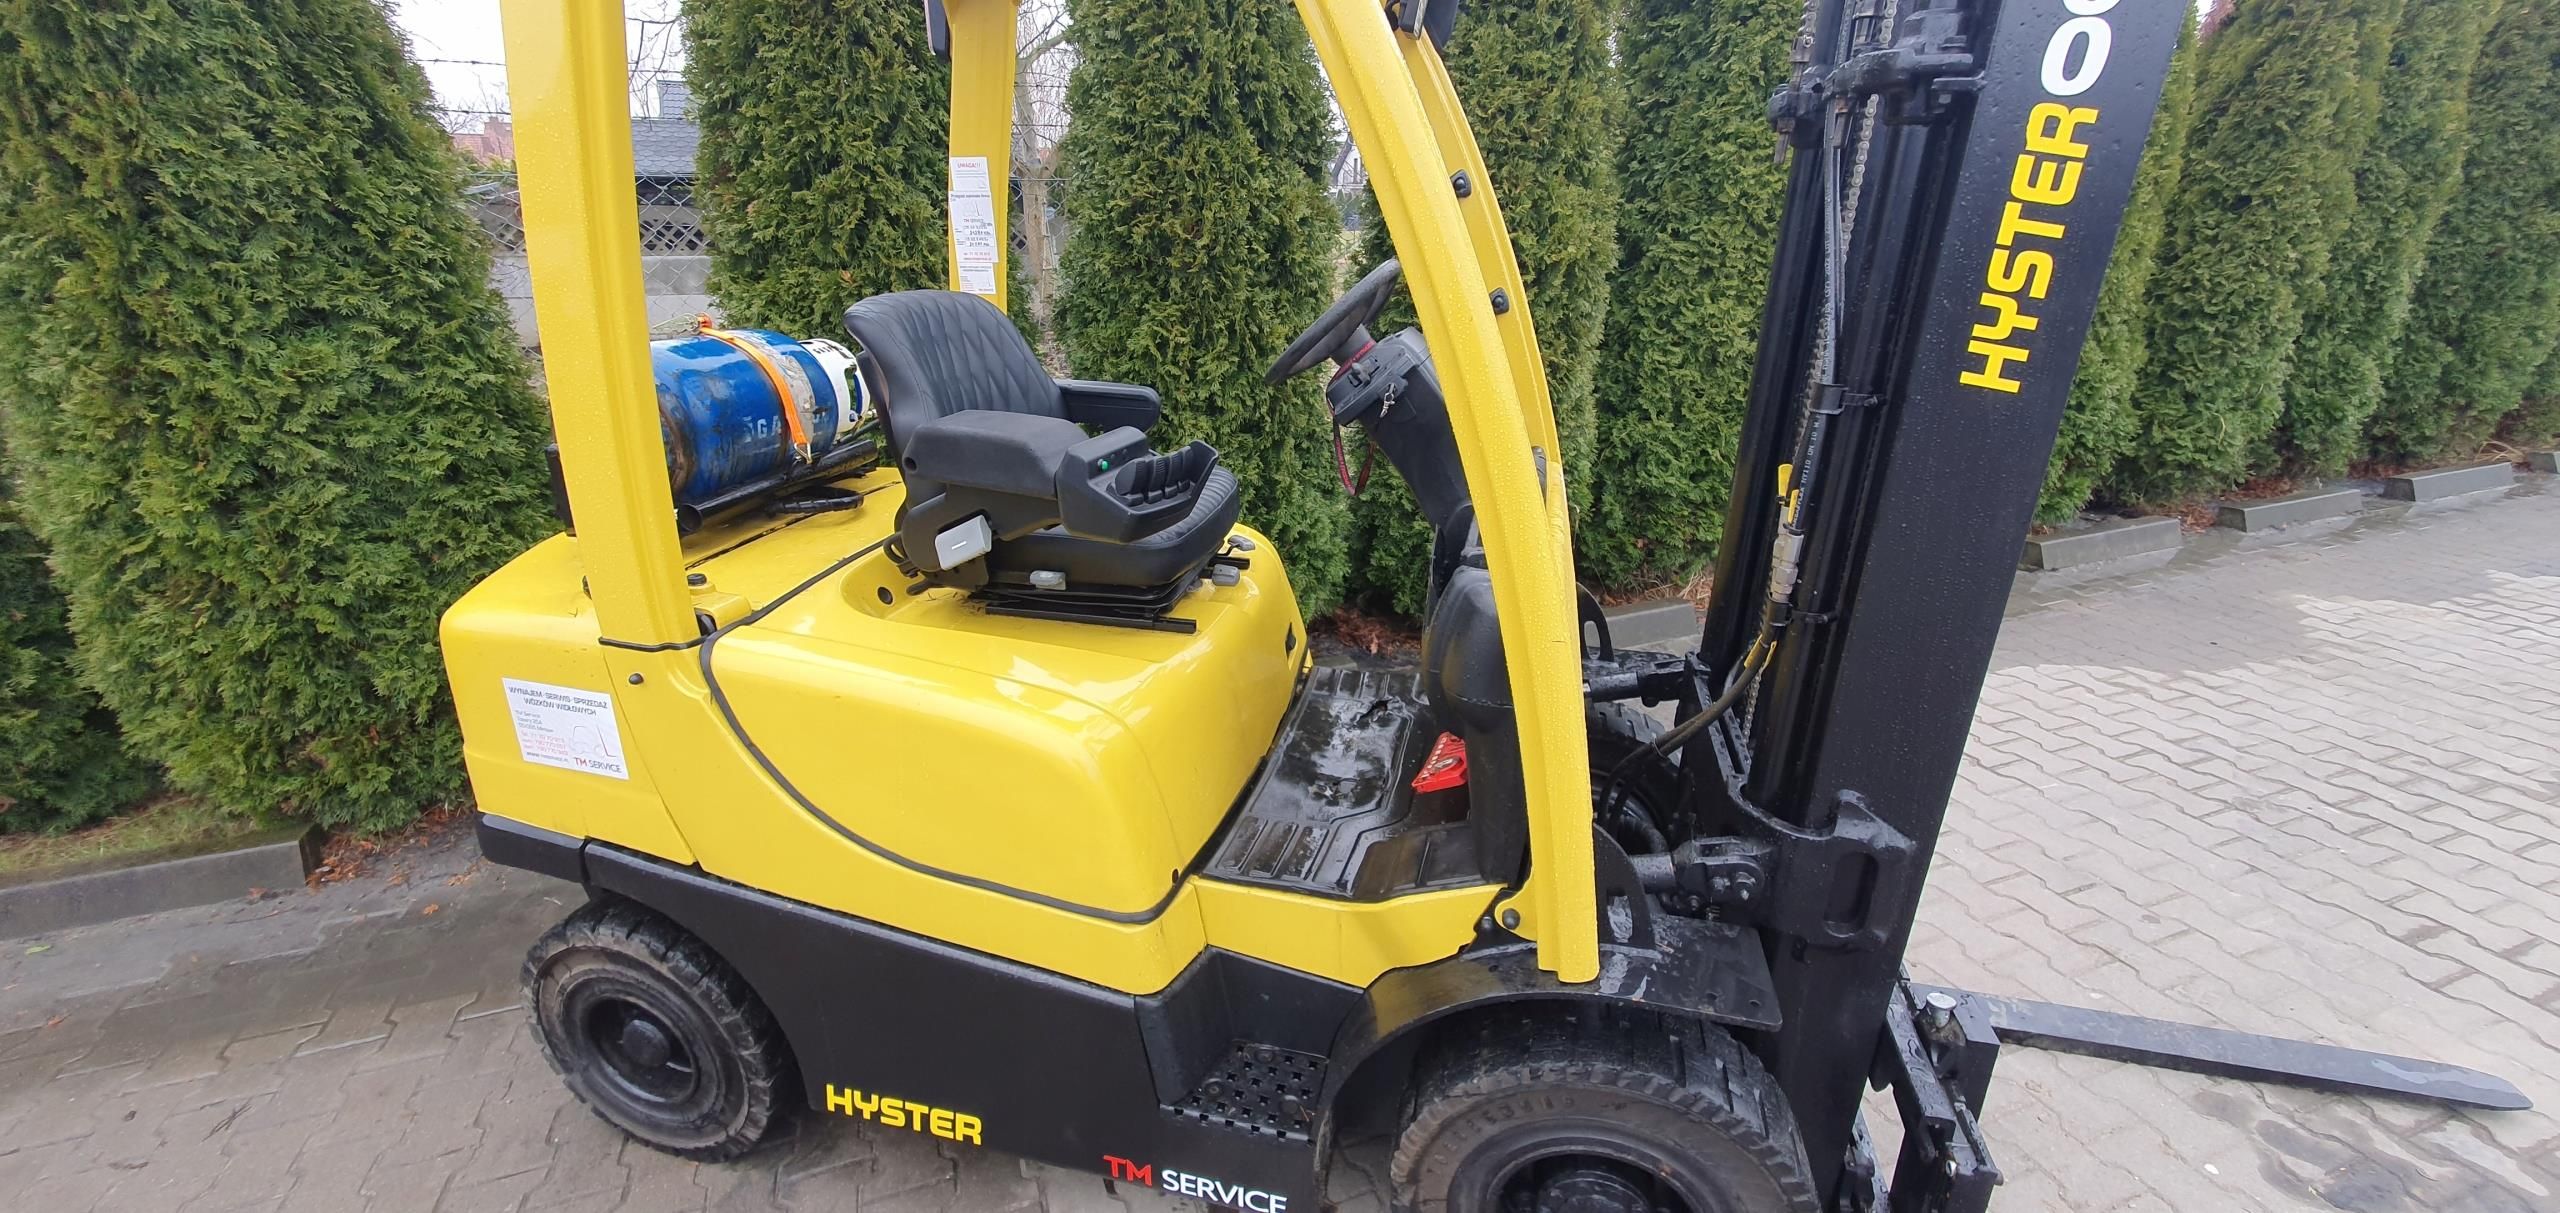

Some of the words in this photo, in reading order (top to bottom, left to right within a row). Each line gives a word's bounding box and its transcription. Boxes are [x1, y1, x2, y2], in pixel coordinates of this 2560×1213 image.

[1959, 102, 2099, 394] HYSTER
[825, 1083, 982, 1145] HYSTER
[1103, 1154, 1153, 1187] TM
